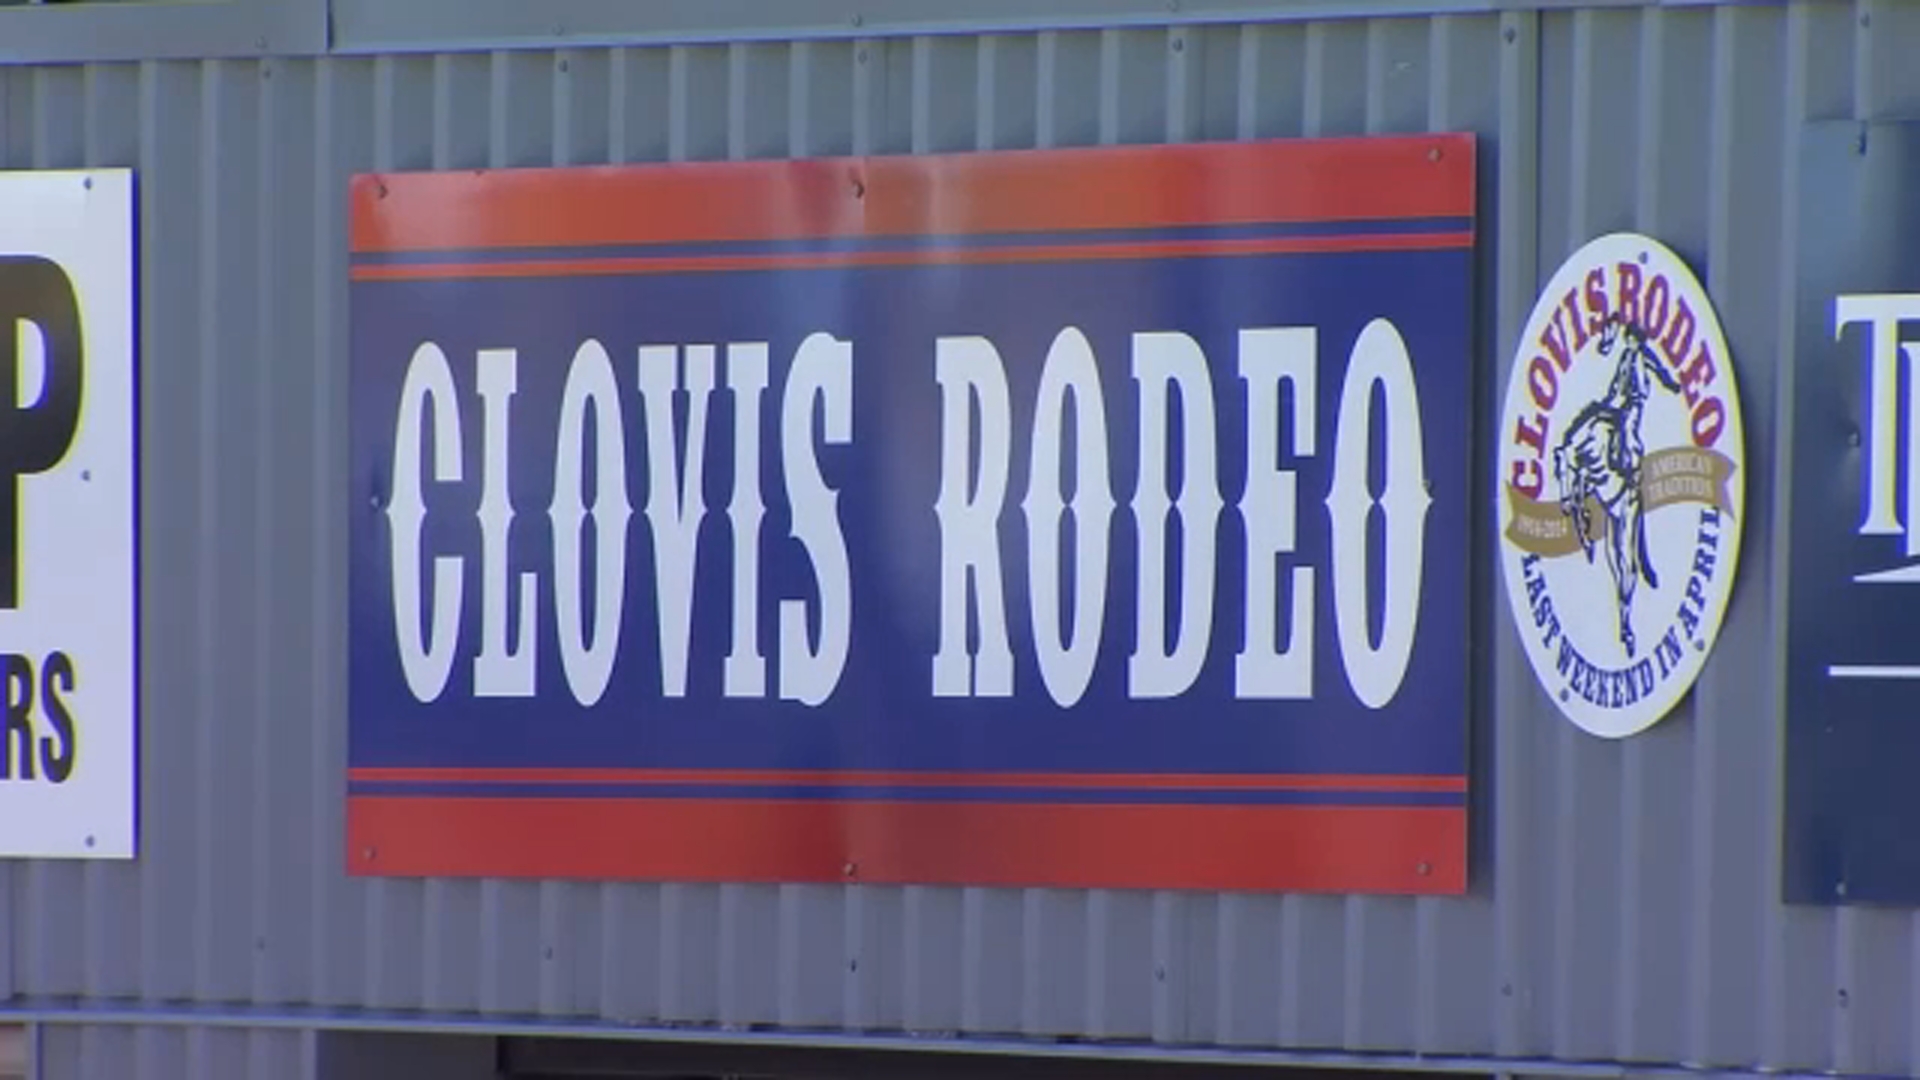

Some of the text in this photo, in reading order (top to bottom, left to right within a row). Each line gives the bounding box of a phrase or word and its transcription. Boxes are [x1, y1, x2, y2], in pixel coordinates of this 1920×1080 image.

[1512, 261, 1725, 500] CLOVIS RODEO
[386, 318, 1433, 708] CLOVIS RODEO
[1521, 505, 1720, 708] LAST WEEKEND IN APRIL
